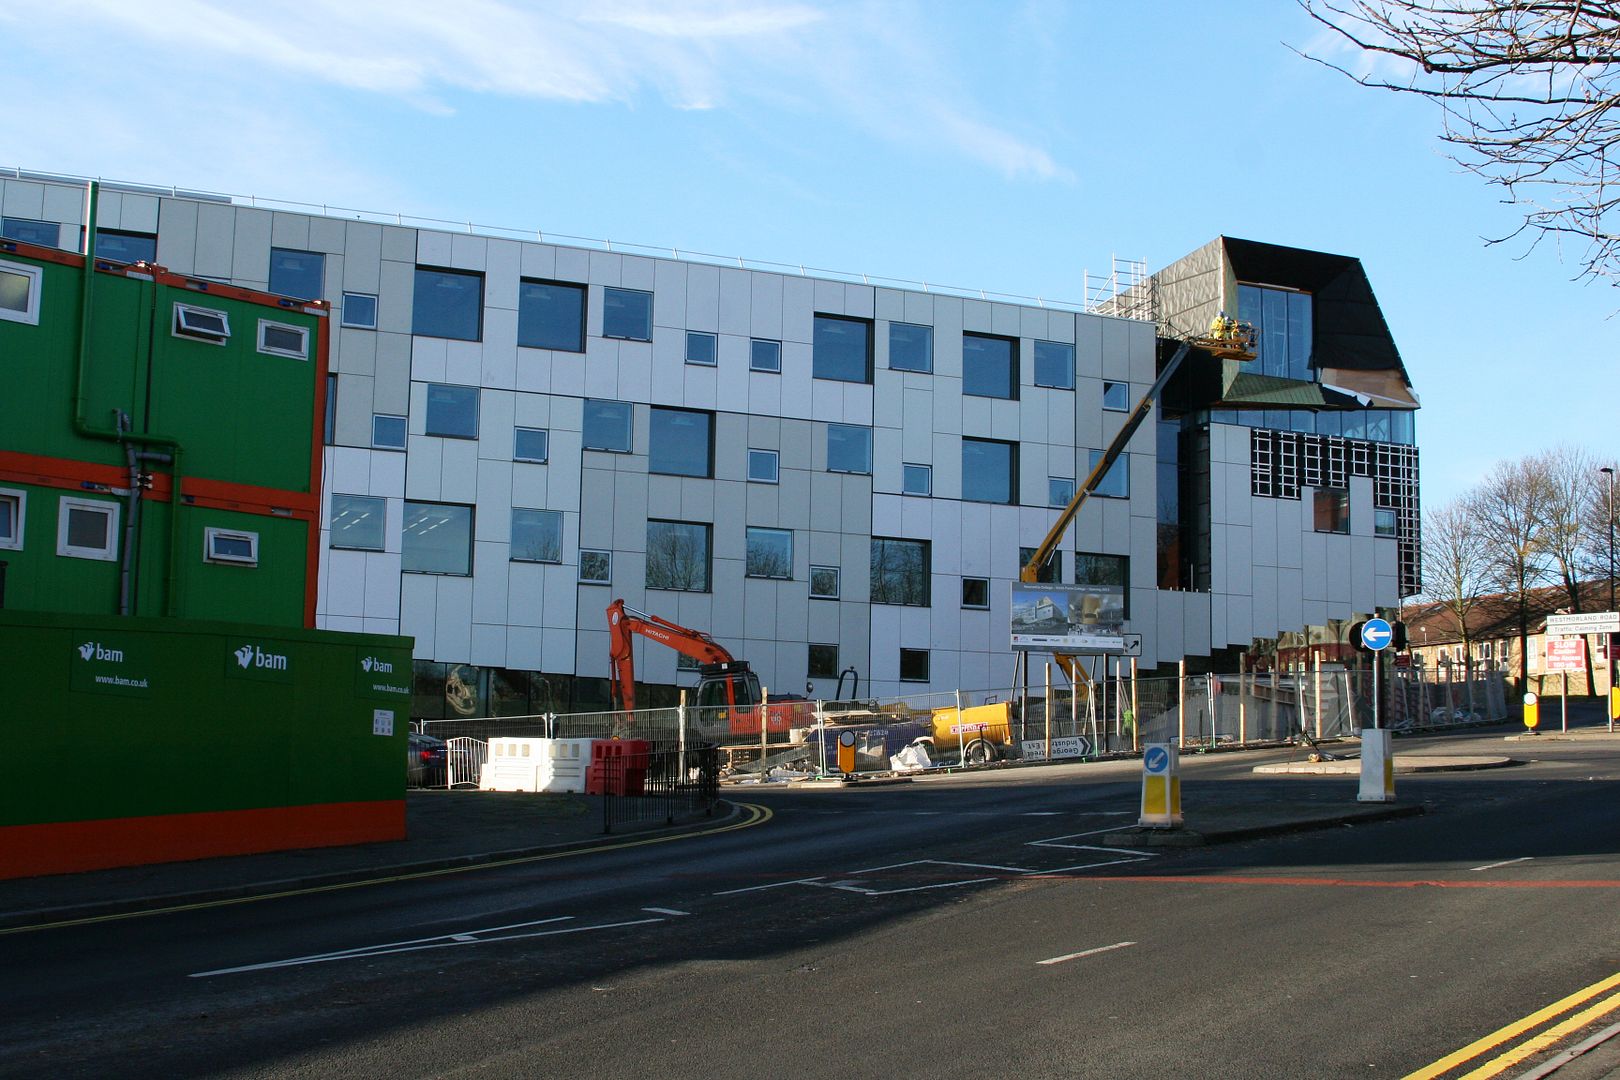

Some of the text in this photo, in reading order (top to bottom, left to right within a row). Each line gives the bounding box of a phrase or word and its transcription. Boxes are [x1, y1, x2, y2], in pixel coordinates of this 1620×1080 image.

[645, 628, 670, 640] HITACHI
[1553, 641, 1577, 649] SLOW
[96, 643, 123, 662] bam
[256, 646, 287, 670] bam
[373, 657, 393, 673] bam
[95, 675, 148, 688] www.bam.co.uk
[1052, 747, 1079, 755] George
